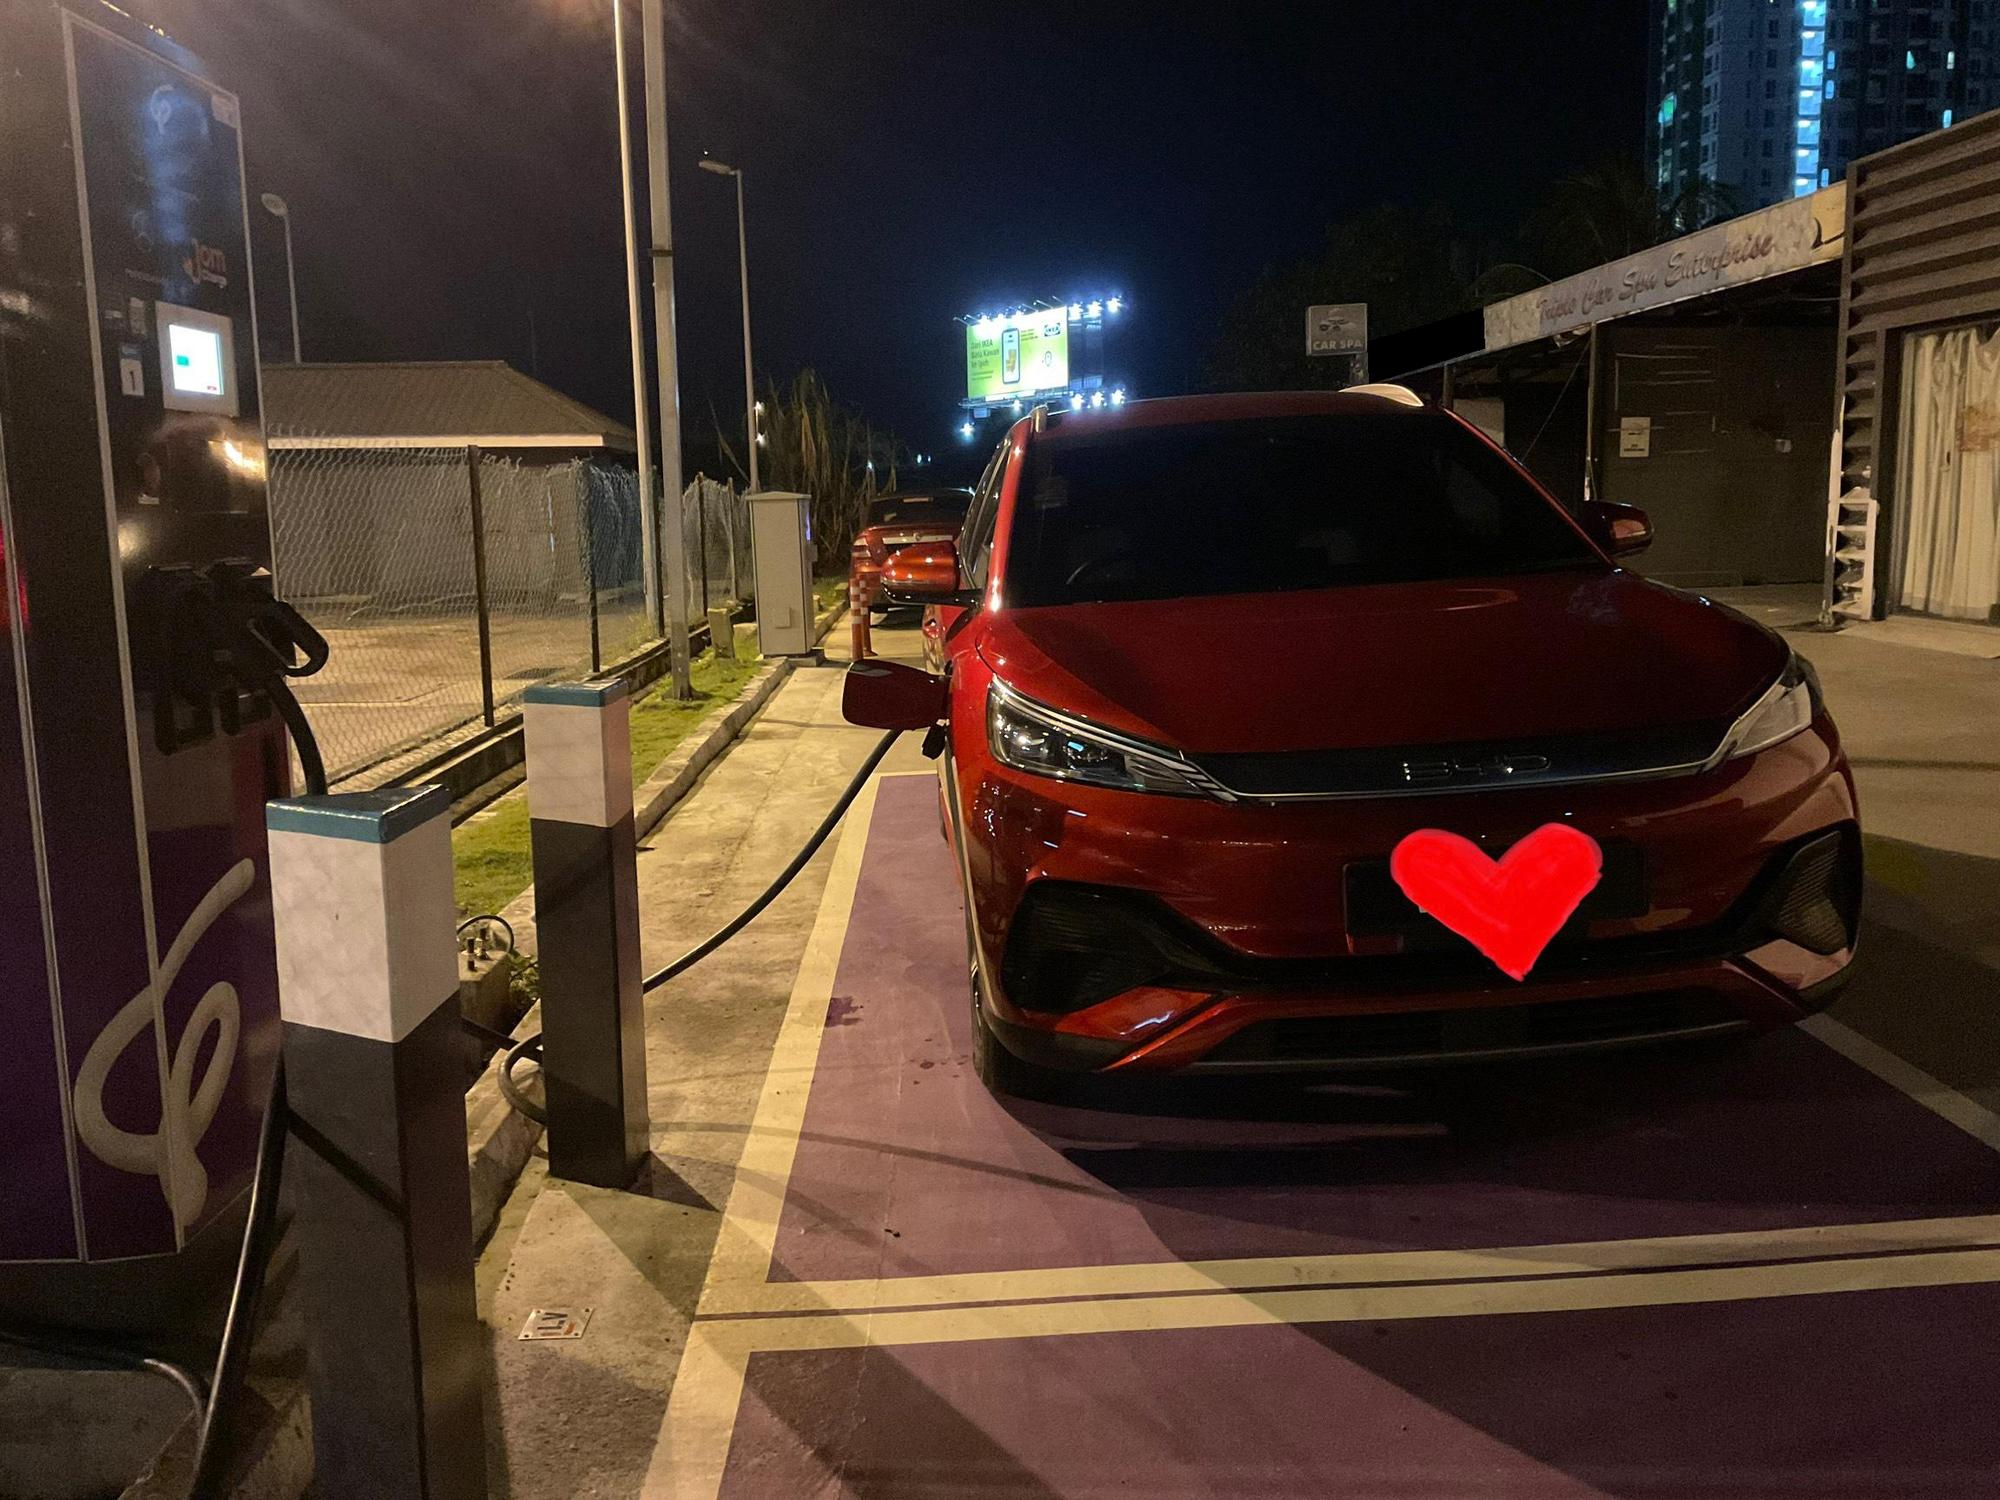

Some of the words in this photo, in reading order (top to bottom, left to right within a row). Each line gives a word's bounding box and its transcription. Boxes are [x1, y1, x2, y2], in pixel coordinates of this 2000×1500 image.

[1618, 265, 1656, 303] Spa
[1664, 233, 1775, 288] Enterprise
[1312, 340, 1337, 351] CAR
[1340, 339, 1363, 349] SPA
[1402, 755, 1551, 781] BYD
